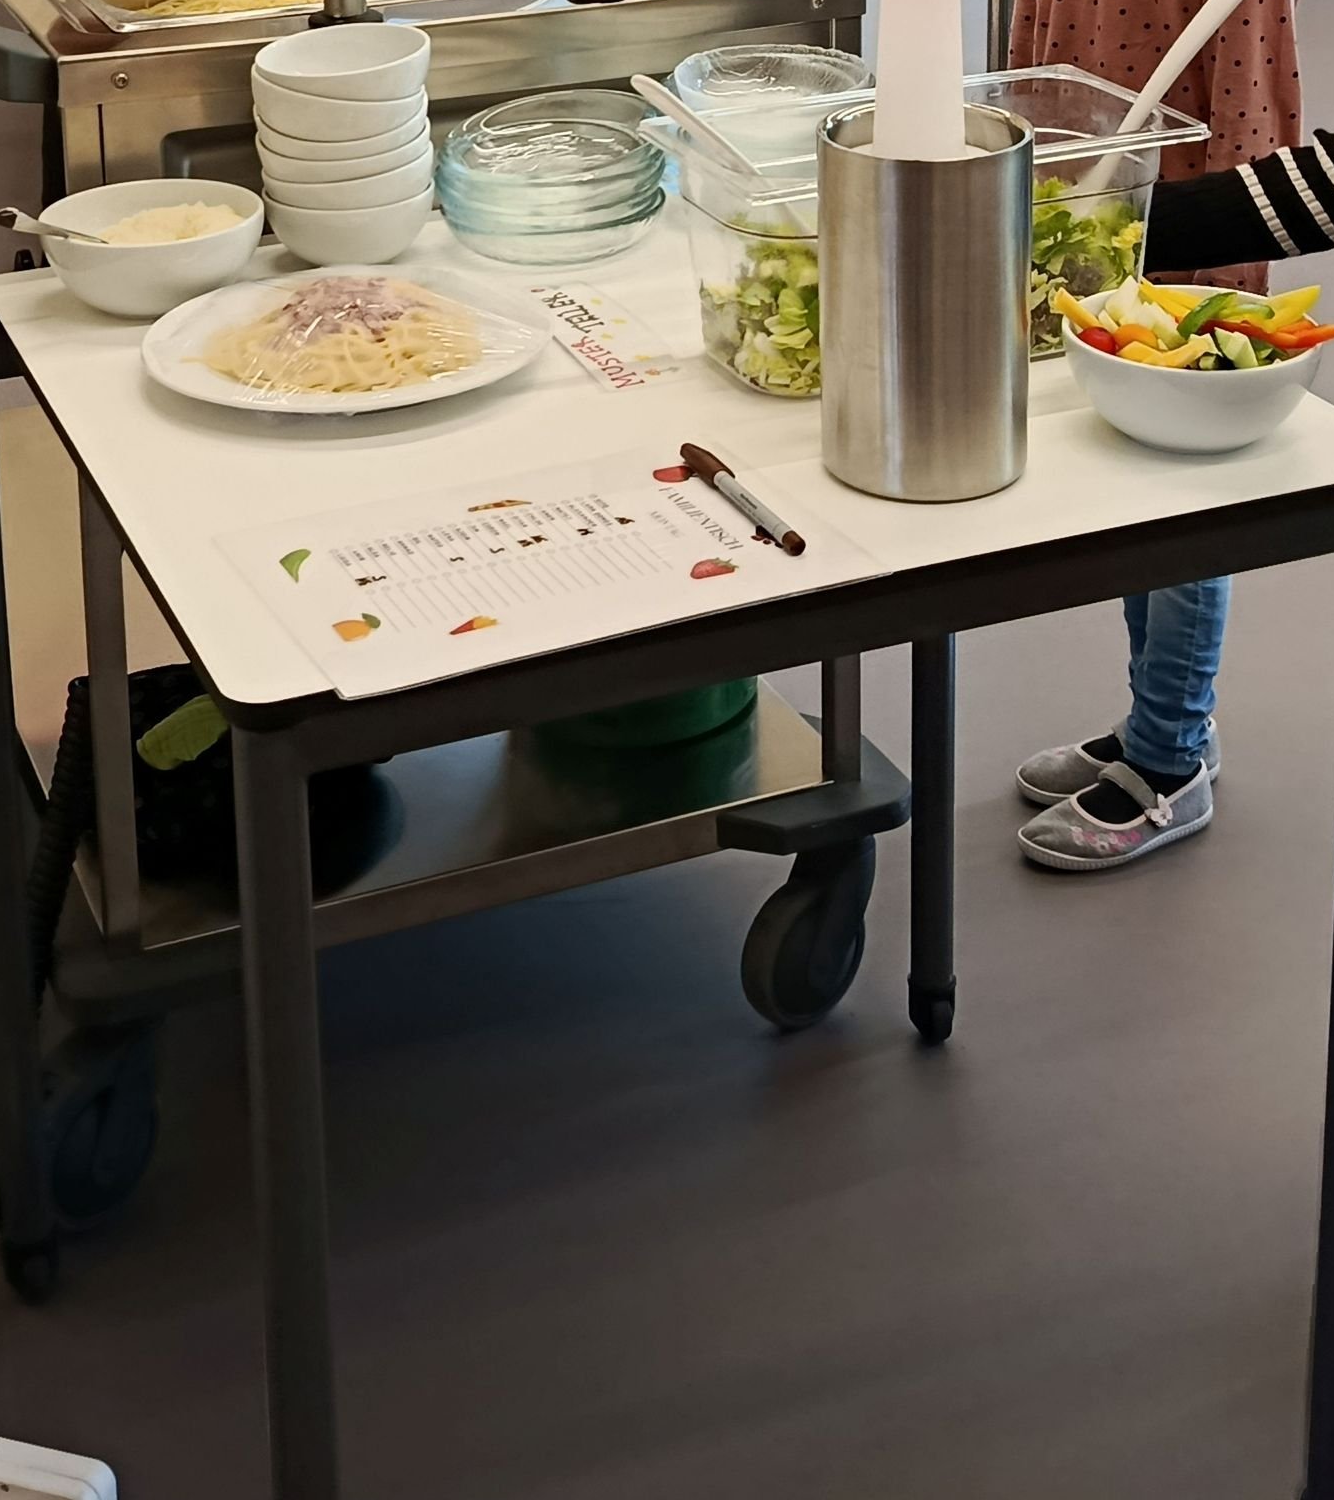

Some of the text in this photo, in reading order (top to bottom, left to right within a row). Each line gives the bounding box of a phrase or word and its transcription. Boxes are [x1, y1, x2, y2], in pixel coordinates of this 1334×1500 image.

[541, 291, 646, 389] MUSTER TELLER
[658, 486, 744, 551] FAMILIENTISCH
